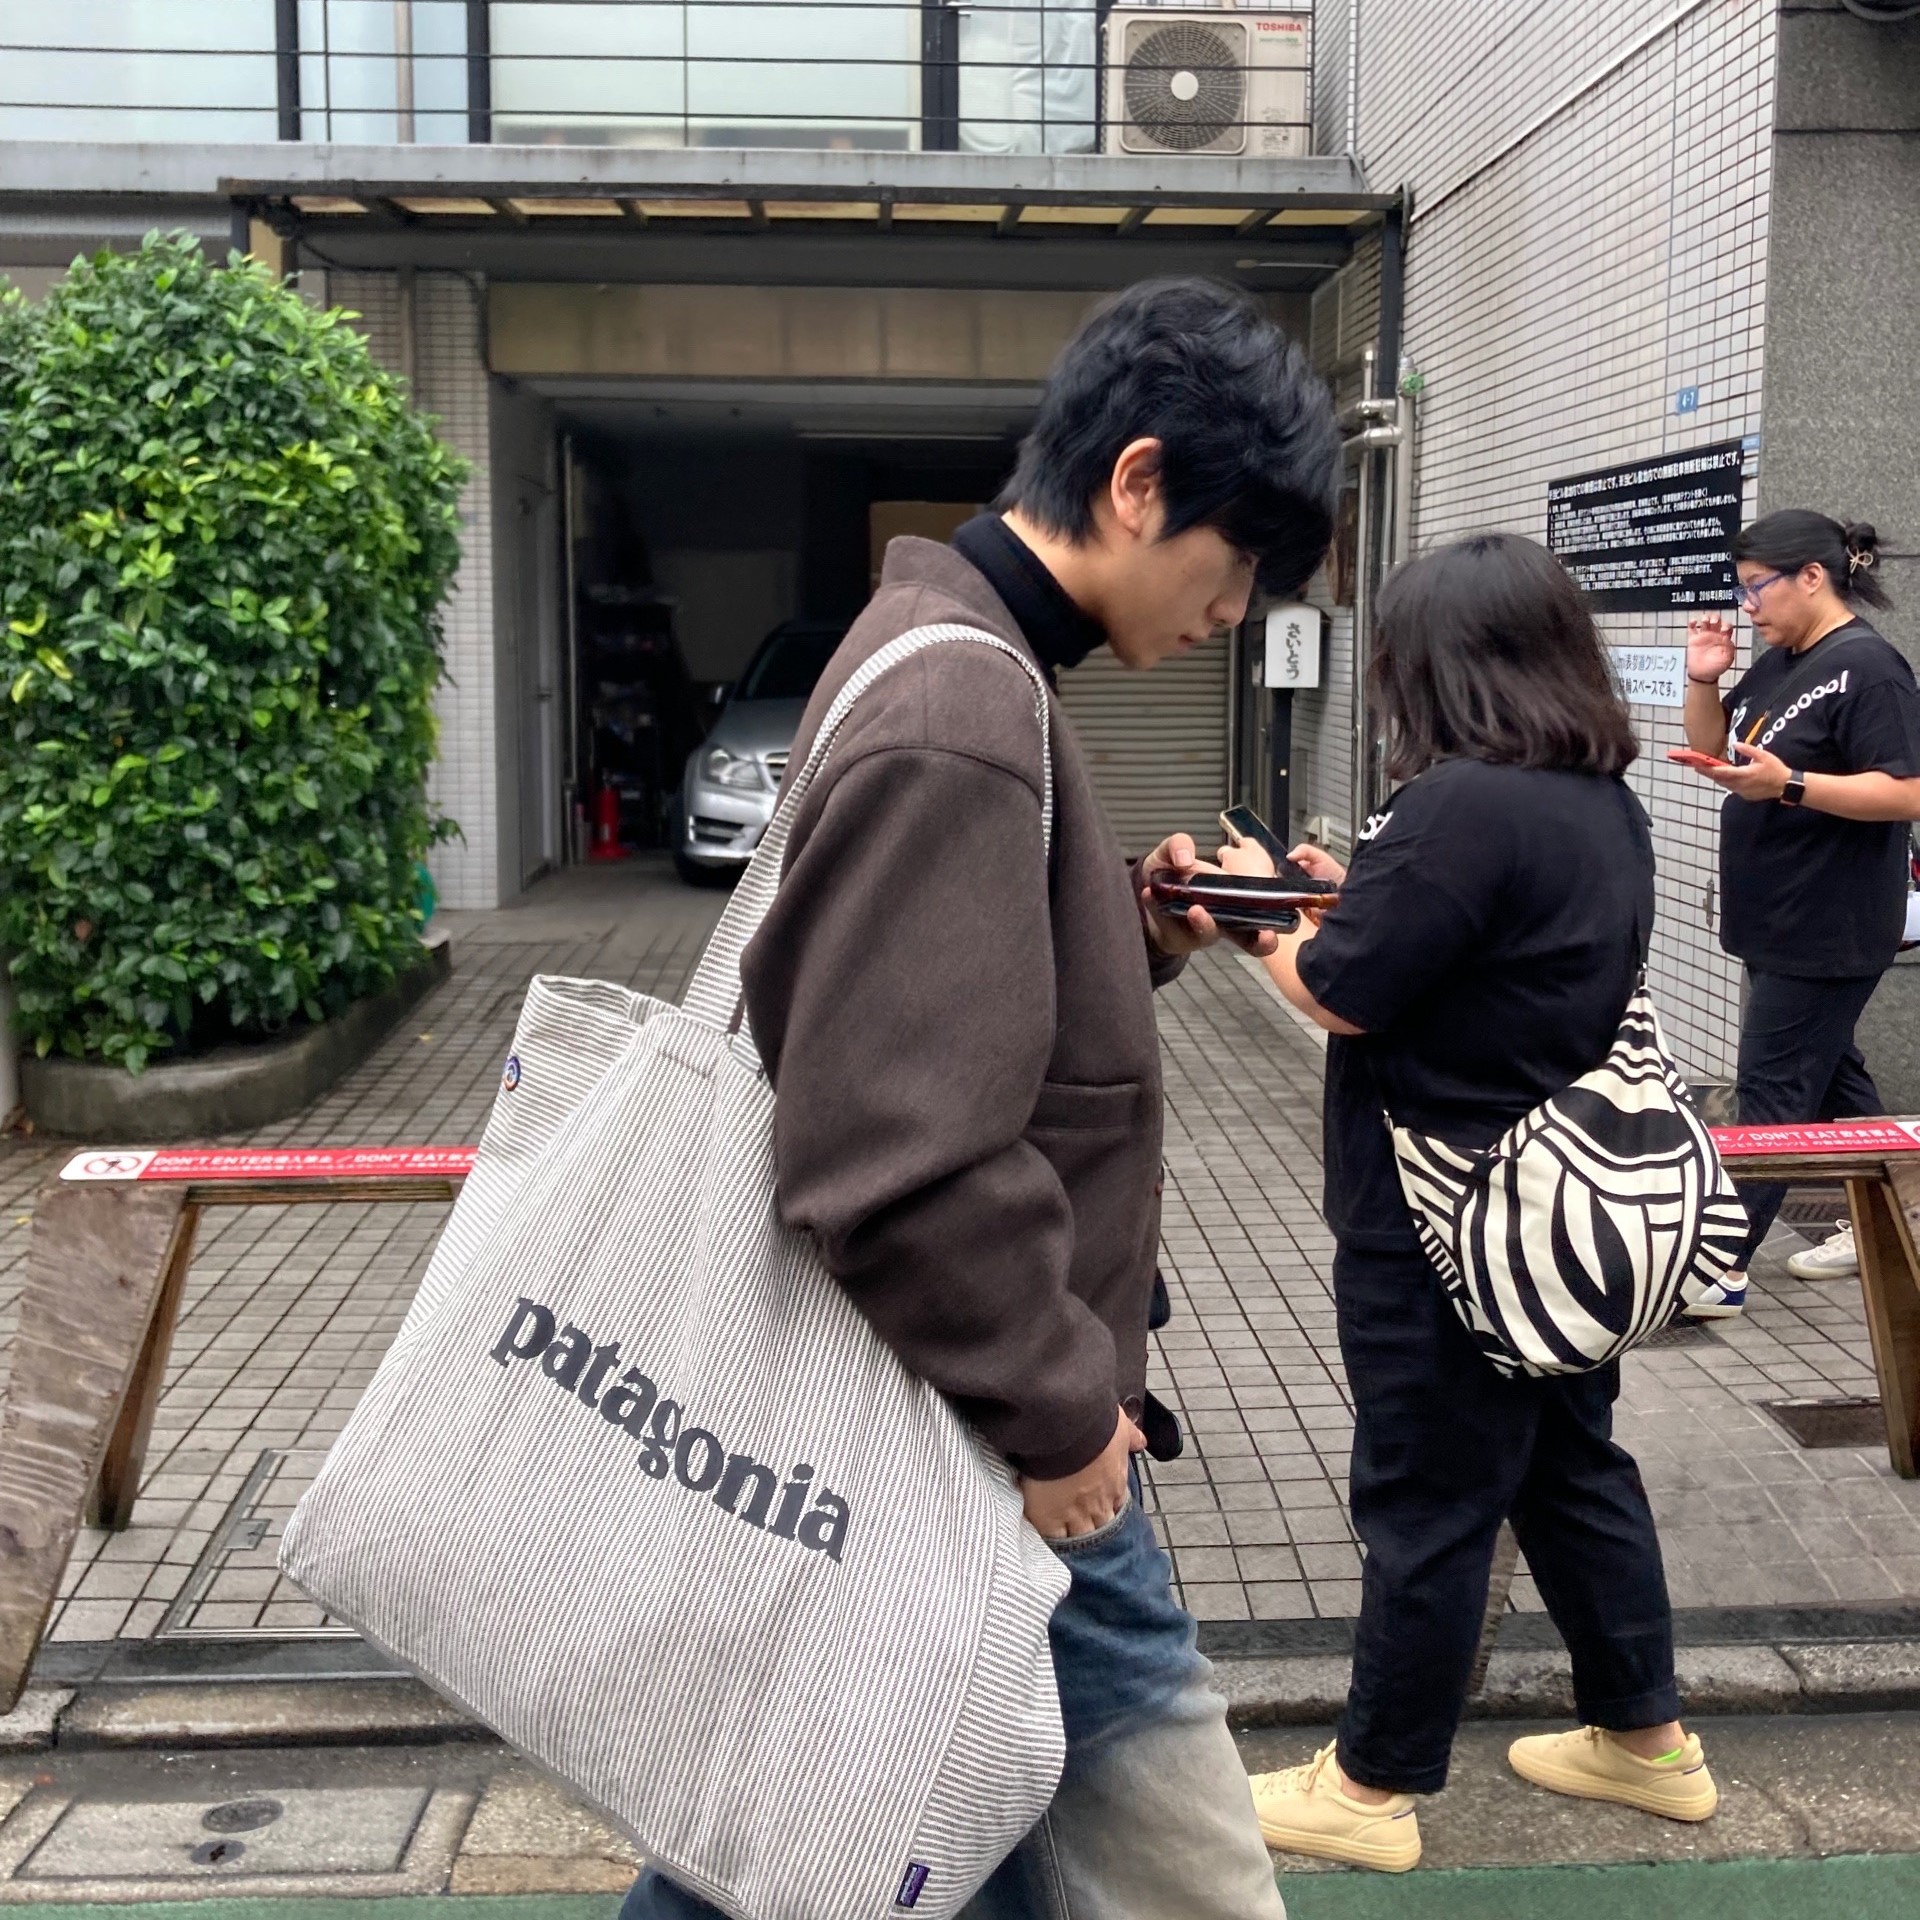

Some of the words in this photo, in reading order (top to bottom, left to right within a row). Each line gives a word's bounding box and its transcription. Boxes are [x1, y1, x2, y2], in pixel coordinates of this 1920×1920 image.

[1256, 22, 1303, 32] TOSHIBA
[1285, 622, 1302, 680] さいとう
[1748, 1131, 1802, 1141] DON'T
[1804, 1130, 1838, 1139] EAT
[153, 1156, 209, 1166] DON'T
[210, 1155, 273, 1165] ENTER
[354, 1153, 409, 1163] DON'T
[411, 1152, 447, 1162] EAT
[489, 1297, 851, 1563] patagonia
